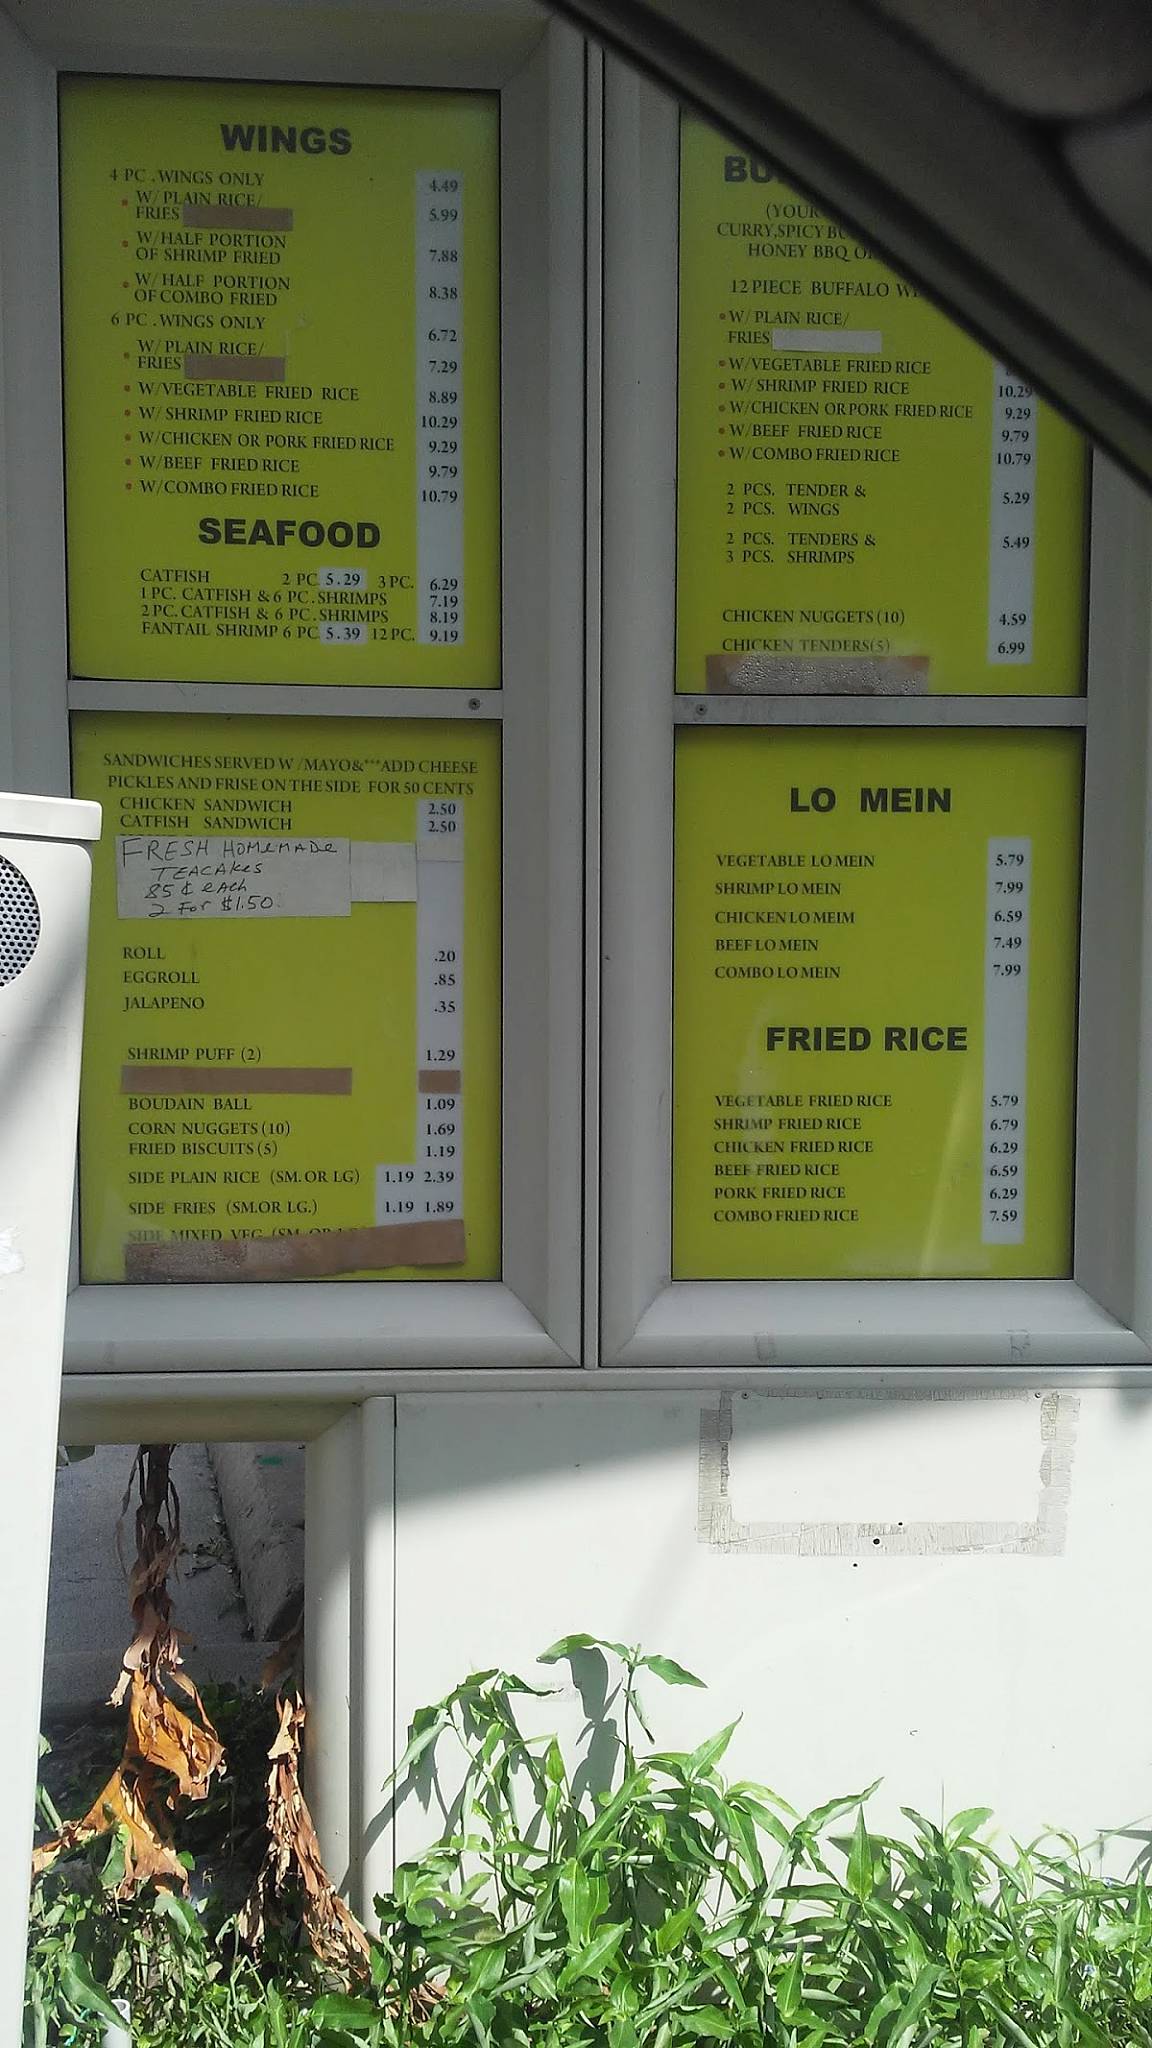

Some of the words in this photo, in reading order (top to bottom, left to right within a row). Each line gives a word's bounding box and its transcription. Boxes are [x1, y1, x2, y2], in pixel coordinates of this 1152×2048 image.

[220, 124, 352, 155] WINGS
[219, 172, 264, 186] ONLY
[429, 179, 459, 192] 4.49
[136, 206, 179, 220] FRIES
[429, 208, 458, 222] 5.99
[208, 234, 285, 251] PORTION
[136, 247, 158, 261] OF
[163, 246, 228, 263] SHRIMP
[232, 249, 280, 264] FRIED
[429, 249, 457, 262] 7.88
[749, 243, 808, 258] HONEY
[814, 245, 850, 264] BBQ
[212, 275, 289, 292] PORTION
[753, 280, 801, 295] PIECE
[810, 281, 889, 296] BUFFALO
[160, 287, 225, 304] COMBO
[230, 290, 277, 306] FRIED
[429, 287, 457, 300] 8.38
[220, 315, 265, 329] ONLY
[428, 329, 457, 342] 6.72
[728, 331, 771, 344] FRIES
[139, 356, 183, 370] FRIES
[429, 360, 457, 373] 7.29
[847, 360, 892, 373] FRIED
[894, 361, 930, 374] RICE
[264, 386, 312, 399] FRIED
[322, 388, 358, 400] RICE
[822, 380, 867, 393] FRIED
[872, 379, 909, 397] RICE
[429, 391, 457, 404] 8.89
[233, 409, 281, 423] FRIED
[285, 411, 322, 424] RICE
[1006, 407, 1031, 420] 9.29
[422, 416, 457, 428] 10.29
[798, 425, 845, 440] FRIED
[845, 425, 882, 440] RICE
[1002, 430, 1029, 442] 9.79
[238, 432, 262, 447] OR
[264, 433, 307, 448] PORK
[312, 436, 356, 449] FRIED
[358, 438, 393, 450] RICE
[429, 441, 457, 453] 9.29
[815, 448, 862, 464] FRIED
[863, 449, 900, 462] RICE
[998, 453, 1031, 464] 10.79
[211, 456, 260, 472] FRIED
[261, 456, 299, 472] RICE
[429, 465, 457, 478] 9.79
[230, 480, 279, 496] FRIED
[280, 484, 318, 497] RICE
[785, 484, 848, 497] TENDER
[423, 490, 457, 502] 10.79
[1003, 492, 1030, 504] 5.29
[788, 503, 839, 516] WINGS
[199, 518, 380, 548] SEAFOOD
[788, 533, 858, 548] TENDERS
[1003, 536, 1029, 549] 5.49
[788, 548, 854, 563] SHRIMPS
[141, 569, 209, 583] CATFISH
[430, 579, 457, 591] 6.29
[182, 588, 251, 606] CATFISH
[430, 595, 458, 608] 7.19
[181, 605, 250, 619] CATFISH
[430, 612, 458, 623] 8.19
[723, 610, 793, 622] CHICKEN
[1000, 614, 1026, 625] 4.59
[143, 622, 210, 635] FANTAIL
[216, 624, 279, 637] SHRIMP
[430, 630, 458, 642] 9.19
[998, 642, 1024, 654] 6.99
[417, 761, 478, 776] CHEESE
[369, 781, 400, 793] FOR
[421, 780, 473, 795] CENTS
[120, 797, 196, 810] CHICKEN
[204, 799, 291, 815] SANDWICH
[791, 788, 836, 812] LO
[861, 788, 951, 812] MEIN
[429, 803, 456, 815] 2.50
[120, 815, 190, 830] CATFISH
[204, 815, 291, 830] SANDWICH
[428, 821, 456, 832] 2.50
[122, 838, 208, 867] FRESH
[717, 855, 805, 867] VEGETABLE
[996, 854, 1024, 866] 5.79
[144, 883, 174, 899] 85
[996, 882, 1023, 893] 7.99
[148, 904, 167, 917] 2
[221, 896, 273, 911] $1.50
[994, 911, 1022, 922] 6.59
[994, 937, 1022, 949] 7.49
[123, 947, 165, 959] ROLL
[435, 951, 455, 962] .20
[993, 964, 1021, 976] 7.99
[124, 971, 199, 984] EGGROLL
[434, 974, 455, 986] .85
[123, 997, 204, 1009] JALAPENO
[435, 1001, 455, 1013] .35
[767, 1027, 871, 1051] FRIED
[885, 1027, 967, 1051] RICE
[128, 1048, 189, 1060] SHRIMP
[194, 1048, 234, 1060] PUFF
[427, 1050, 455, 1061] 1.29
[129, 1098, 206, 1110] BOUDAIN
[213, 1098, 251, 1110] BALL
[427, 1099, 455, 1110] 1.09
[810, 1095, 853, 1107] FRIED
[857, 1096, 892, 1106] RICE
[991, 1095, 1018, 1107] 5.79
[129, 1122, 176, 1135] CORN
[182, 1122, 259, 1135] NUGGETS
[427, 1123, 455, 1135] 1.69
[778, 1118, 822, 1129] FRIED
[826, 1118, 861, 1130] RICE
[990, 1119, 1018, 1131] 6.79
[130, 1142, 176, 1155] FRIED
[182, 1142, 254, 1155] BISCUITS
[427, 1146, 455, 1157] 1.19
[791, 1141, 836, 1152] FRIED
[838, 1141, 872, 1152] RICE
[990, 1142, 1018, 1154] 6.29
[757, 1164, 801, 1176] FRIED
[805, 1164, 839, 1176] RICE
[990, 1165, 1017, 1176] 6.59
[129, 1172, 165, 1184] SIDE
[169, 1172, 216, 1183] PLAIN
[224, 1171, 260, 1183] RICE
[386, 1171, 414, 1183] 1.19
[424, 1171, 454, 1183] 2.39
[715, 1187, 757, 1199] PORK
[763, 1187, 807, 1199] FRIED
[811, 1187, 845, 1199] RICE
[990, 1188, 1017, 1199] 6.29
[129, 1200, 165, 1214] SIDE
[174, 1202, 217, 1214] FRIES
[386, 1202, 414, 1212] 1.19
[426, 1201, 453, 1212] 1.89
[714, 1210, 772, 1221] COMBO
[774, 1210, 820, 1221] FRIED
[824, 1210, 858, 1221] RICE
[990, 1210, 1017, 1222] 7.59
